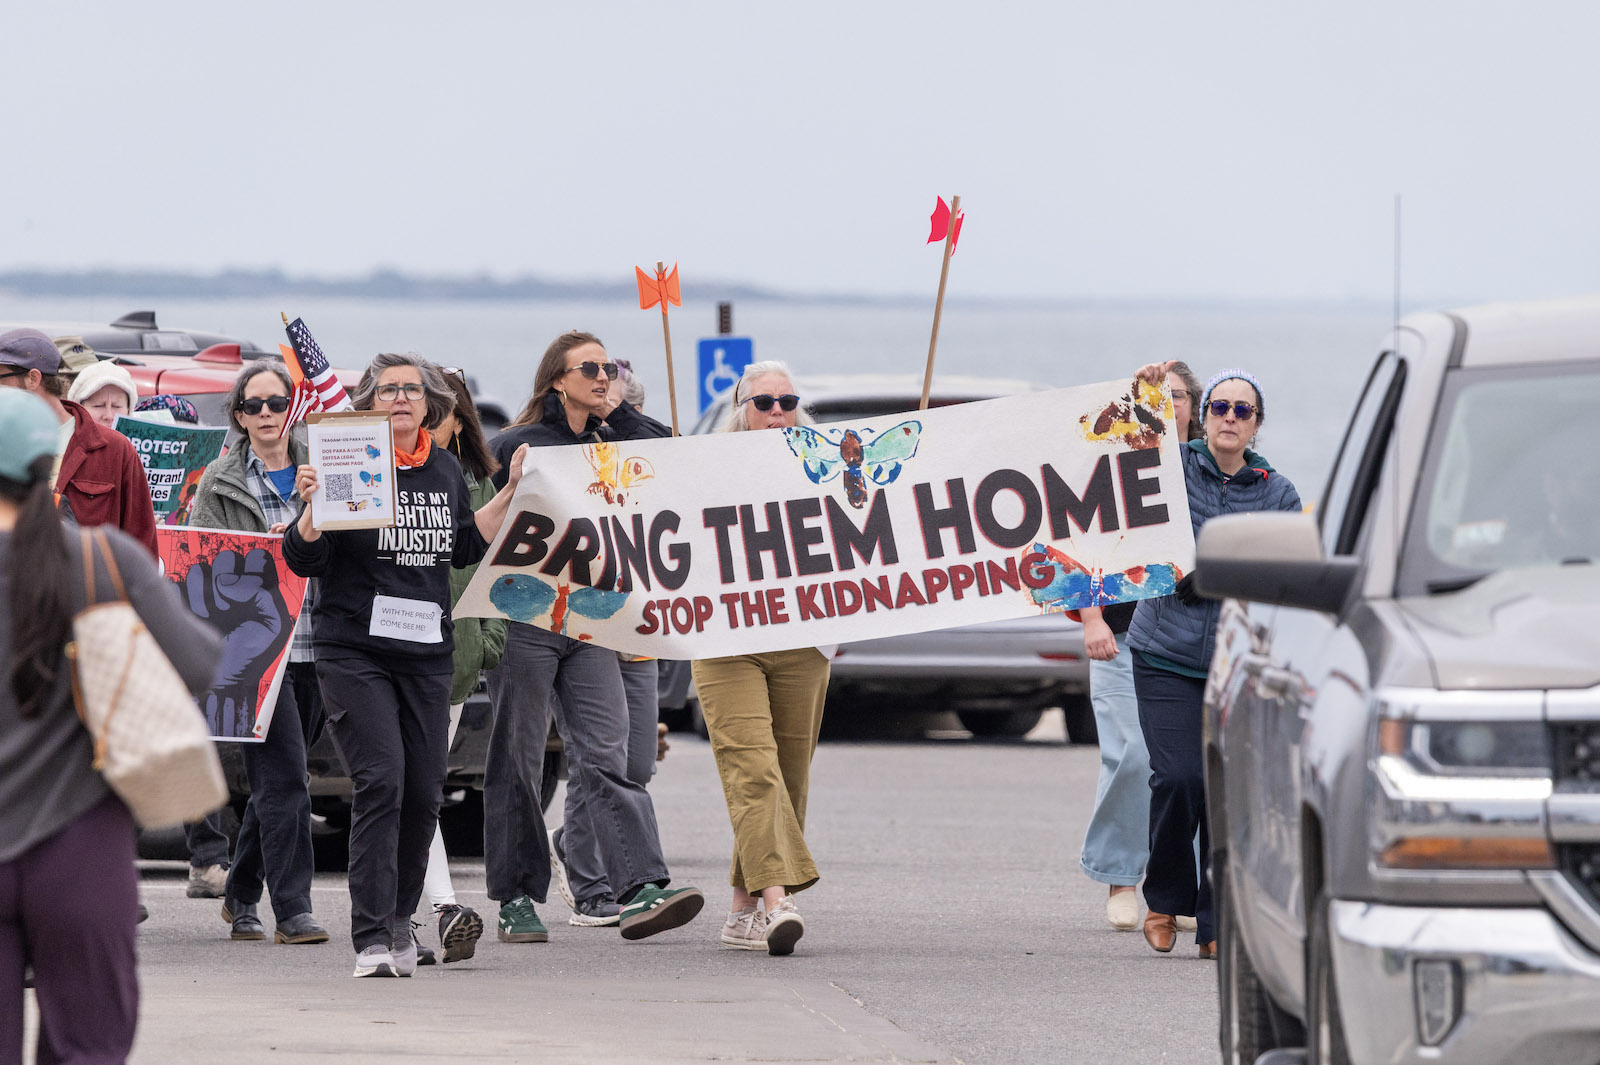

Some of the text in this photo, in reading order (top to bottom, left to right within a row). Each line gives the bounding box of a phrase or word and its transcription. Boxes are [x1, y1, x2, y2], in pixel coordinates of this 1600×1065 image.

[127, 437, 188, 454] ROTECT
[145, 470, 182, 485] igrant
[412, 491, 426, 505] IS
[429, 492, 448, 505] MY
[396, 505, 452, 528] GHTING
[490, 447, 1170, 594] BRING THEM HOME
[378, 528, 453, 552] INJUSTICE
[396, 552, 437, 566] HOODIE
[636, 552, 1056, 635] STOP THE KIDNAPPING
[381, 607, 436, 621] WITH THE PRESS?
[380, 619, 426, 632] COME SEE ME!
